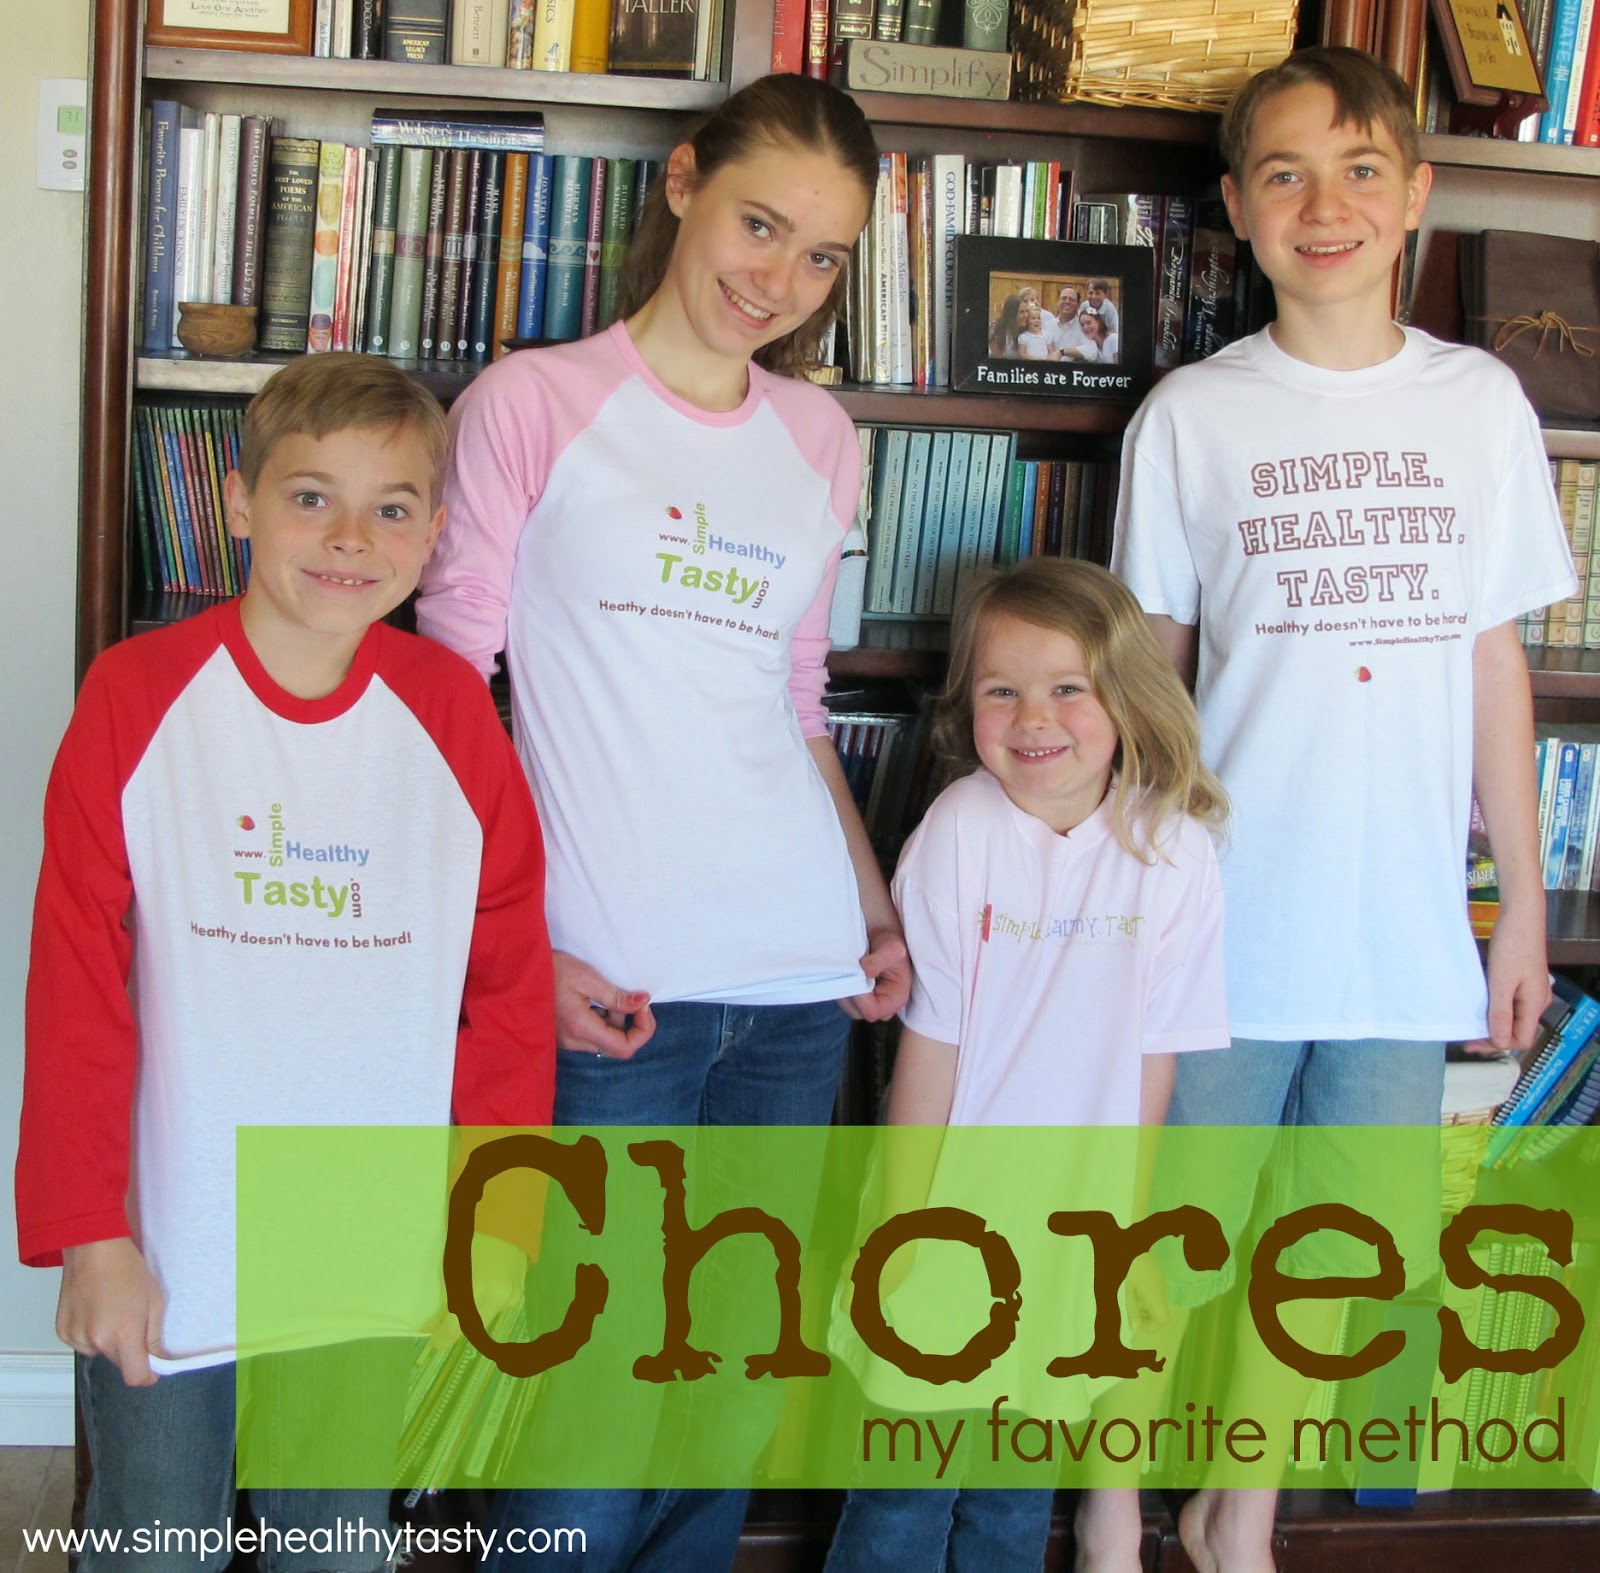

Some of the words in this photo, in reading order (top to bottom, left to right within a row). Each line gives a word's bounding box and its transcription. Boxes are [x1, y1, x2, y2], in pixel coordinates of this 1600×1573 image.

[362, 0, 373, 31] OCCA
[402, 38, 430, 46] AMERICAN
[860, 46, 1001, 96] Simplify
[157, 120, 169, 164] Favorite
[397, 121, 453, 136] Webster's
[457, 130, 521, 145] Thesaurus
[227, 127, 238, 174] PEARSON
[251, 128, 262, 186] BEST-LOVED
[155, 168, 167, 202] Poems
[279, 186, 307, 195] POEMS
[291, 177, 314, 185] LOVED
[385, 156, 395, 192] DANIEL
[432, 164, 440, 194] CONAN
[454, 166, 464, 198] JULES
[513, 166, 523, 195] MARK
[153, 206, 167, 221] for
[178, 187, 188, 216] EMILY
[248, 190, 260, 220] POEMS
[272, 203, 313, 213] AMERICAN
[382, 194, 391, 225] DEFOE
[410, 191, 420, 230] AUSTEN
[429, 198, 437, 227] DOYLE
[451, 200, 461, 231] VERNE
[484, 178, 493, 221] SHELLEY
[492, 190, 500, 215] MARY
[512, 197, 521, 227] TWAIN
[532, 185, 541, 215] SWIFT
[539, 176, 548, 226] JONATHAN
[563, 179, 574, 227] MELVILLE
[572, 183, 581, 223] HERMAN
[612, 186, 621, 227] KIPLING
[619, 185, 628, 230] RUDYARD
[221, 202, 234, 251] beginnings
[152, 225, 165, 273] Children
[175, 218, 186, 276] DICKINSON
[897, 230, 906, 258] Seven
[219, 263, 231, 295] beyond
[244, 262, 255, 282] LDS
[897, 262, 907, 303] Miracles
[562, 292, 570, 307] Dick
[880, 273, 888, 321] AMERICAN
[977, 366, 1039, 384] Families
[1043, 373, 1066, 385] are
[1072, 371, 1131, 388] Forever
[1250, 451, 1444, 498] SIMPLE.
[659, 533, 690, 546] www.
[692, 502, 709, 555] Simple
[708, 534, 786, 570] Healthy
[1238, 506, 1465, 556] HEALTHY.
[656, 552, 760, 604] Tasty
[751, 576, 770, 609] .com
[1277, 563, 1439, 608] TASTY.
[599, 600, 647, 616] Heathy
[650, 604, 692, 620] doesn't
[694, 611, 722, 626] have
[725, 619, 736, 629] to
[739, 620, 753, 633] be
[1255, 619, 1309, 636] Healthy
[1314, 617, 1367, 632] doesn't
[1370, 616, 1404, 629] have
[1407, 615, 1421, 627] to
[1425, 613, 1440, 626] be
[1442, 612, 1467, 625] hard
[234, 849, 266, 859] www.
[268, 803, 285, 867] Simple
[286, 840, 370, 867] Healthy
[234, 871, 349, 918] Tasty
[350, 878, 362, 918] .com
[191, 921, 237, 943] Heathy
[240, 931, 292, 945] doesn't
[296, 933, 330, 948] have
[334, 936, 348, 948] to
[352, 935, 369, 948] be
[373, 931, 412, 948] hard!
